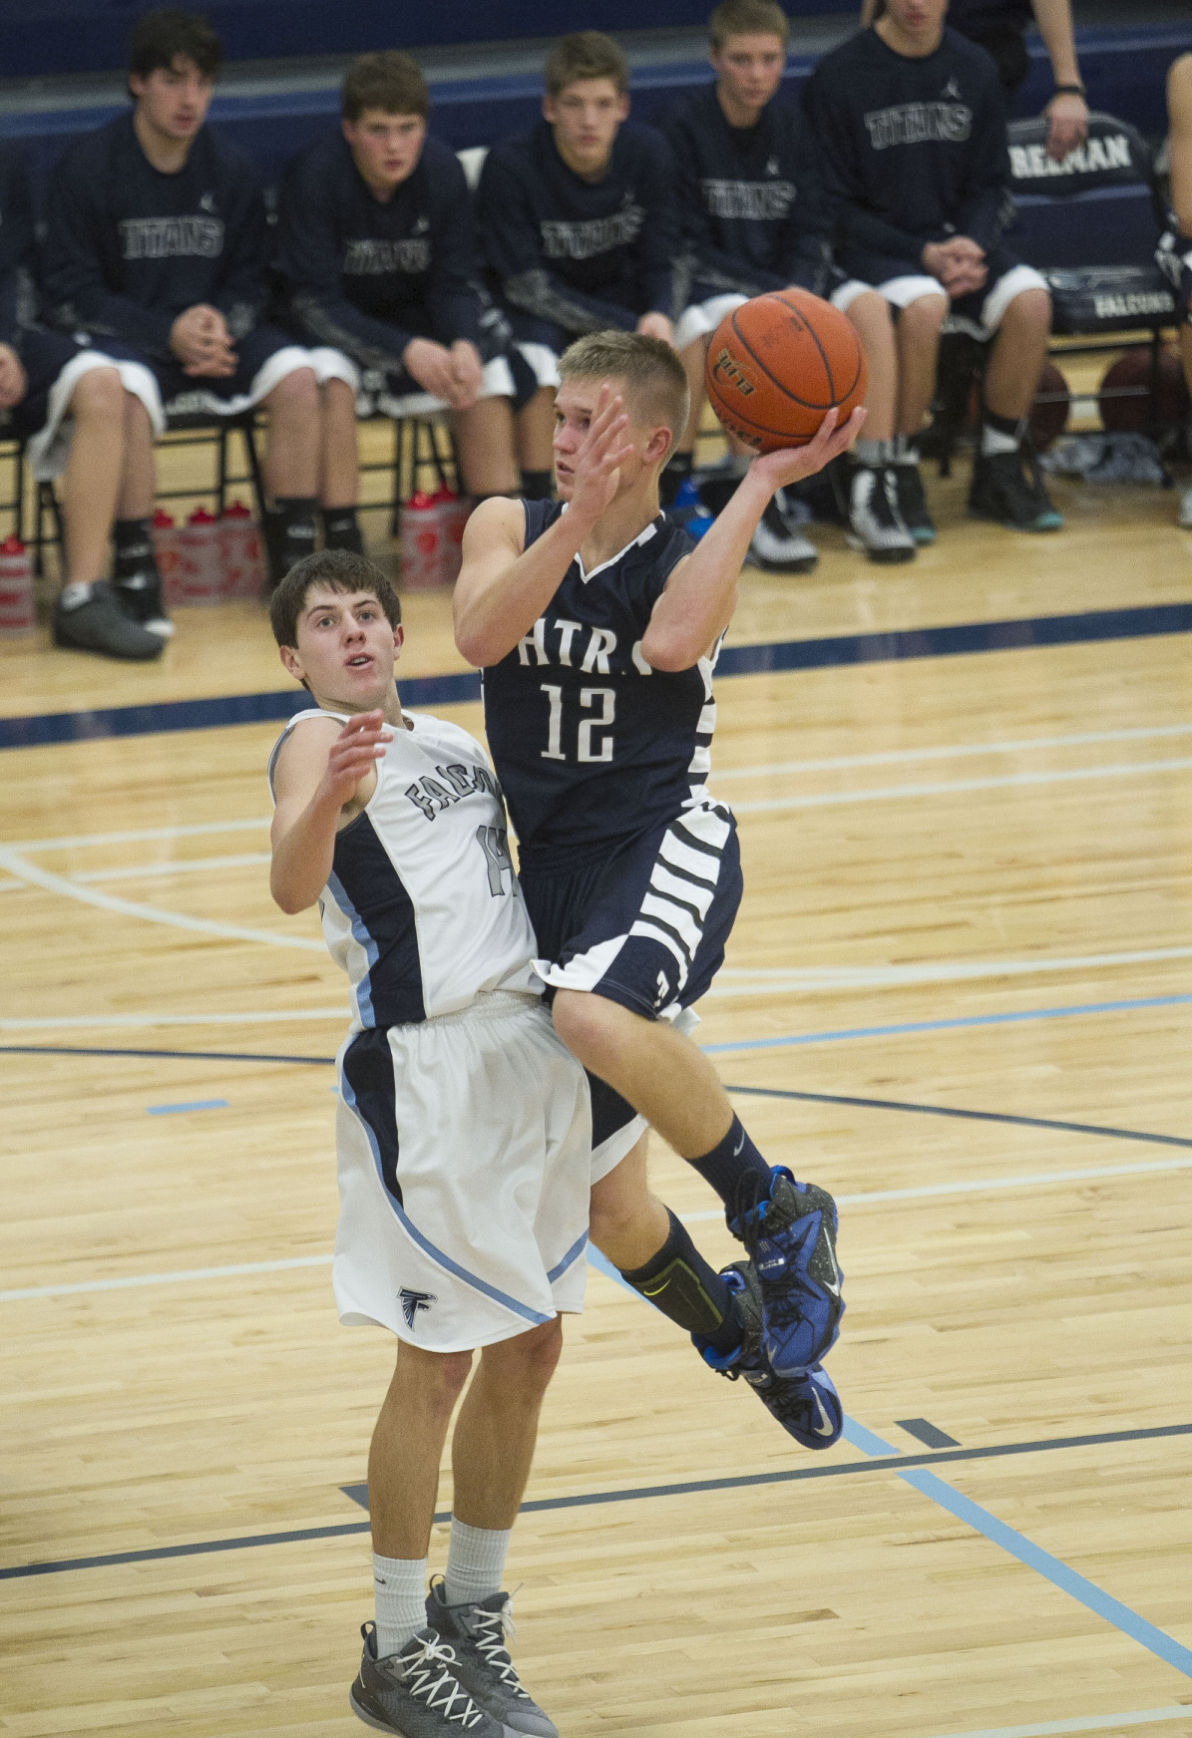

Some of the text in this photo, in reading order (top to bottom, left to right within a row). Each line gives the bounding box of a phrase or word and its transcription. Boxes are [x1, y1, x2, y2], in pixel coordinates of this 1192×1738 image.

[864, 102, 972, 151] TITANS
[118, 216, 225, 259] TITANS
[540, 683, 616, 762] 12
